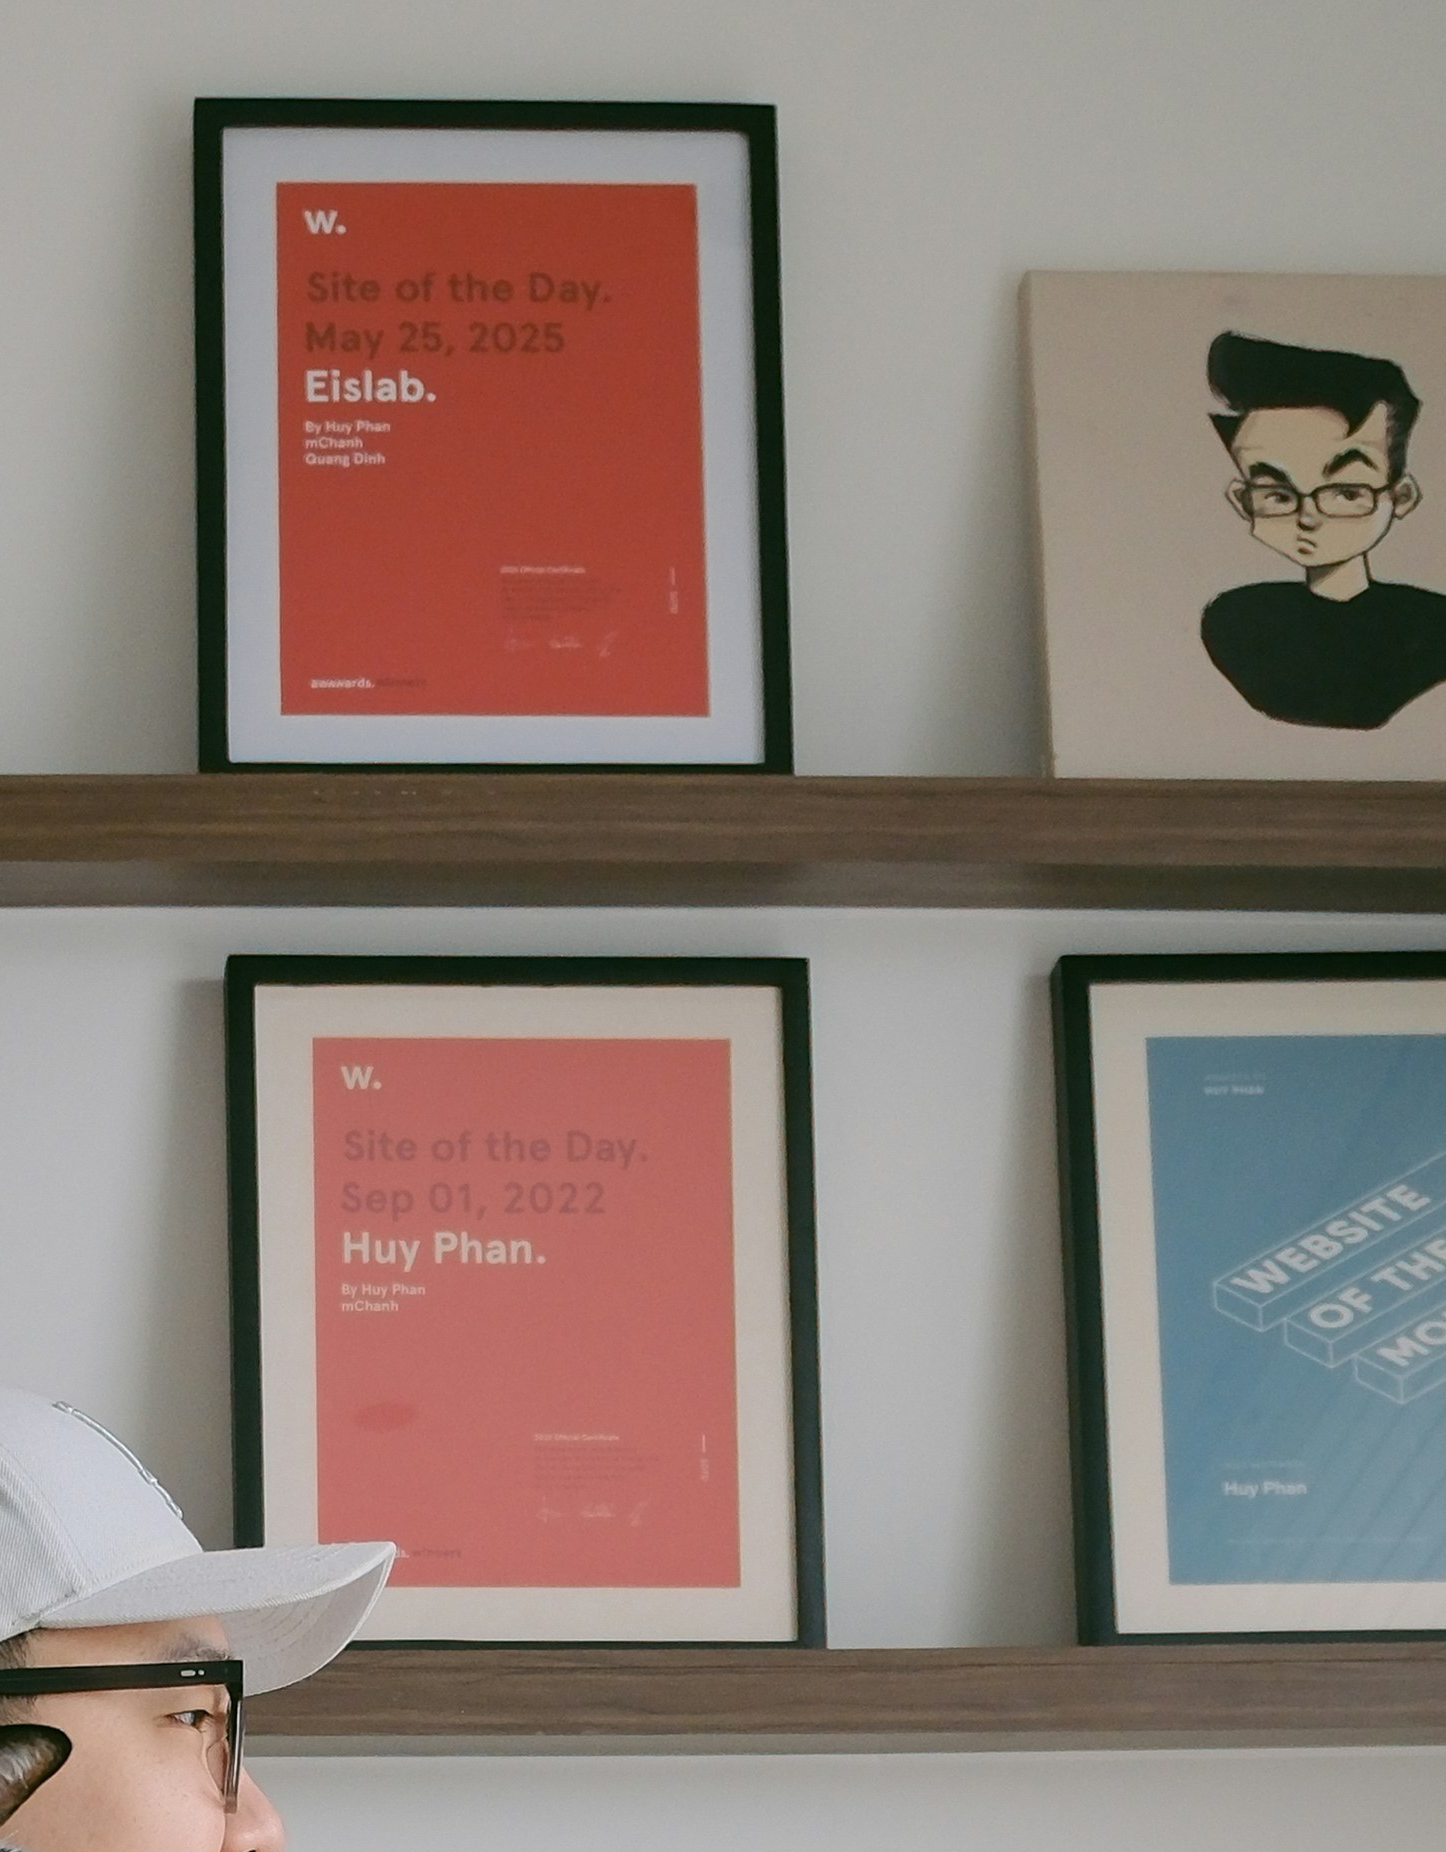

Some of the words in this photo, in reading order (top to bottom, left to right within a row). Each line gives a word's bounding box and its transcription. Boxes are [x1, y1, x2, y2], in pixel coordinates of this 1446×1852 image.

[308, 271, 381, 303] Site
[395, 271, 435, 303] of
[448, 271, 514, 303] the
[529, 272, 610, 312] Day.
[305, 321, 384, 360] May
[398, 321, 454, 356] 25,
[469, 321, 566, 353] 2025
[304, 369, 436, 403] Eislab.
[304, 420, 322, 435] By
[325, 420, 353, 435] Huy
[356, 420, 391, 433] Phan
[305, 436, 364, 449] mChanh
[305, 453, 350, 467] Quang
[353, 453, 385, 464] Dinh
[344, 1129, 417, 1162] Site
[430, 1130, 472, 1162] of
[485, 1130, 551, 1162] the
[566, 1130, 648, 1170] Day.
[341, 1182, 414, 1222] Sep
[428, 1182, 487, 1221] 01,
[504, 1182, 606, 1215] 2022
[343, 1231, 420, 1272] Huy
[434, 1231, 547, 1265] Phan.
[1230, 1184, 1432, 1294] WEBSITE
[341, 1283, 357, 1297] By
[361, 1283, 388, 1297] Huy
[392, 1283, 426, 1295] Phan
[342, 1300, 399, 1312] mChanh
[1308, 1286, 1373, 1329] OF
[1223, 1481, 1259, 1498] Huy
[1262, 1481, 1307, 1495] Phan
